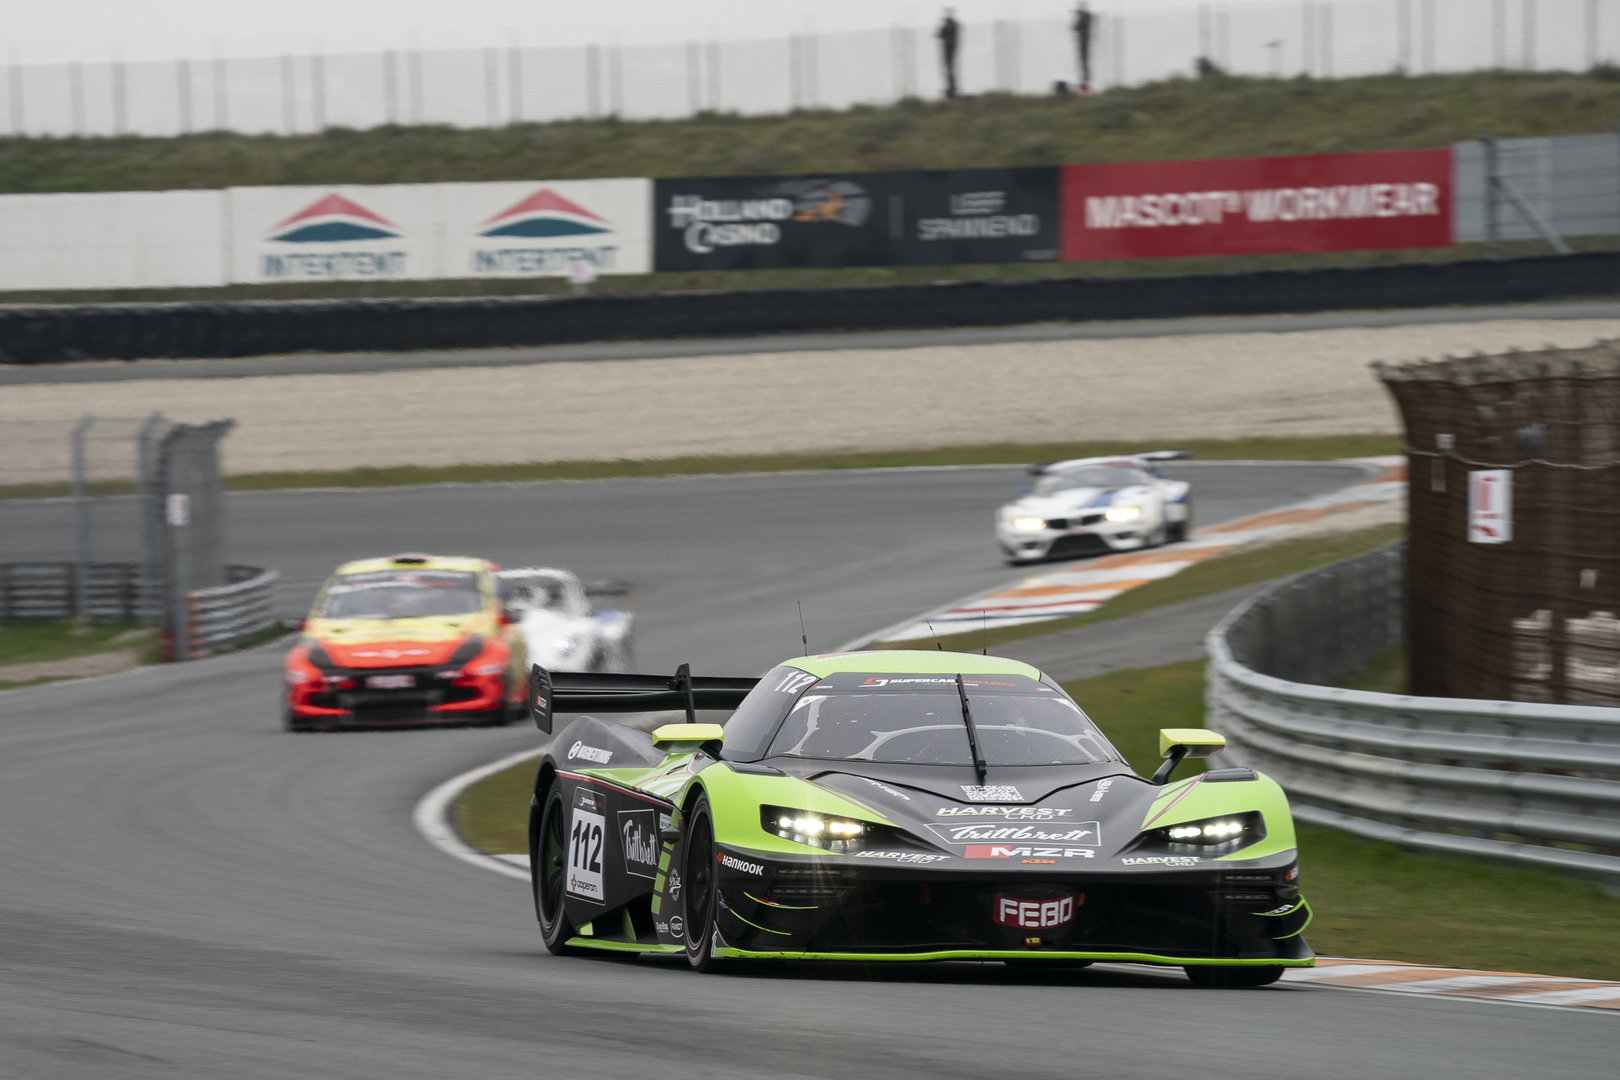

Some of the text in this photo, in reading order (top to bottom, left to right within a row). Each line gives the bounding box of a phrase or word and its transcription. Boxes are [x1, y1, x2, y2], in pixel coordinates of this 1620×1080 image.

[667, 194, 794, 229] HOLLAND
[1244, 182, 1441, 223] WORKWEAR
[684, 221, 781, 254] CASINO
[260, 250, 407, 278] INTERTENT
[775, 671, 817, 694] 112
[889, 677, 957, 685] SUPERCAR
[958, 678, 1018, 688] HALLENGE
[936, 807, 1073, 817] HARVEST
[571, 819, 602, 874] 112
[854, 851, 951, 862] HARVEST
[990, 847, 1096, 859] MZR
[1121, 856, 1201, 865] HARVEST
[1000, 896, 1073, 928] FEBO
